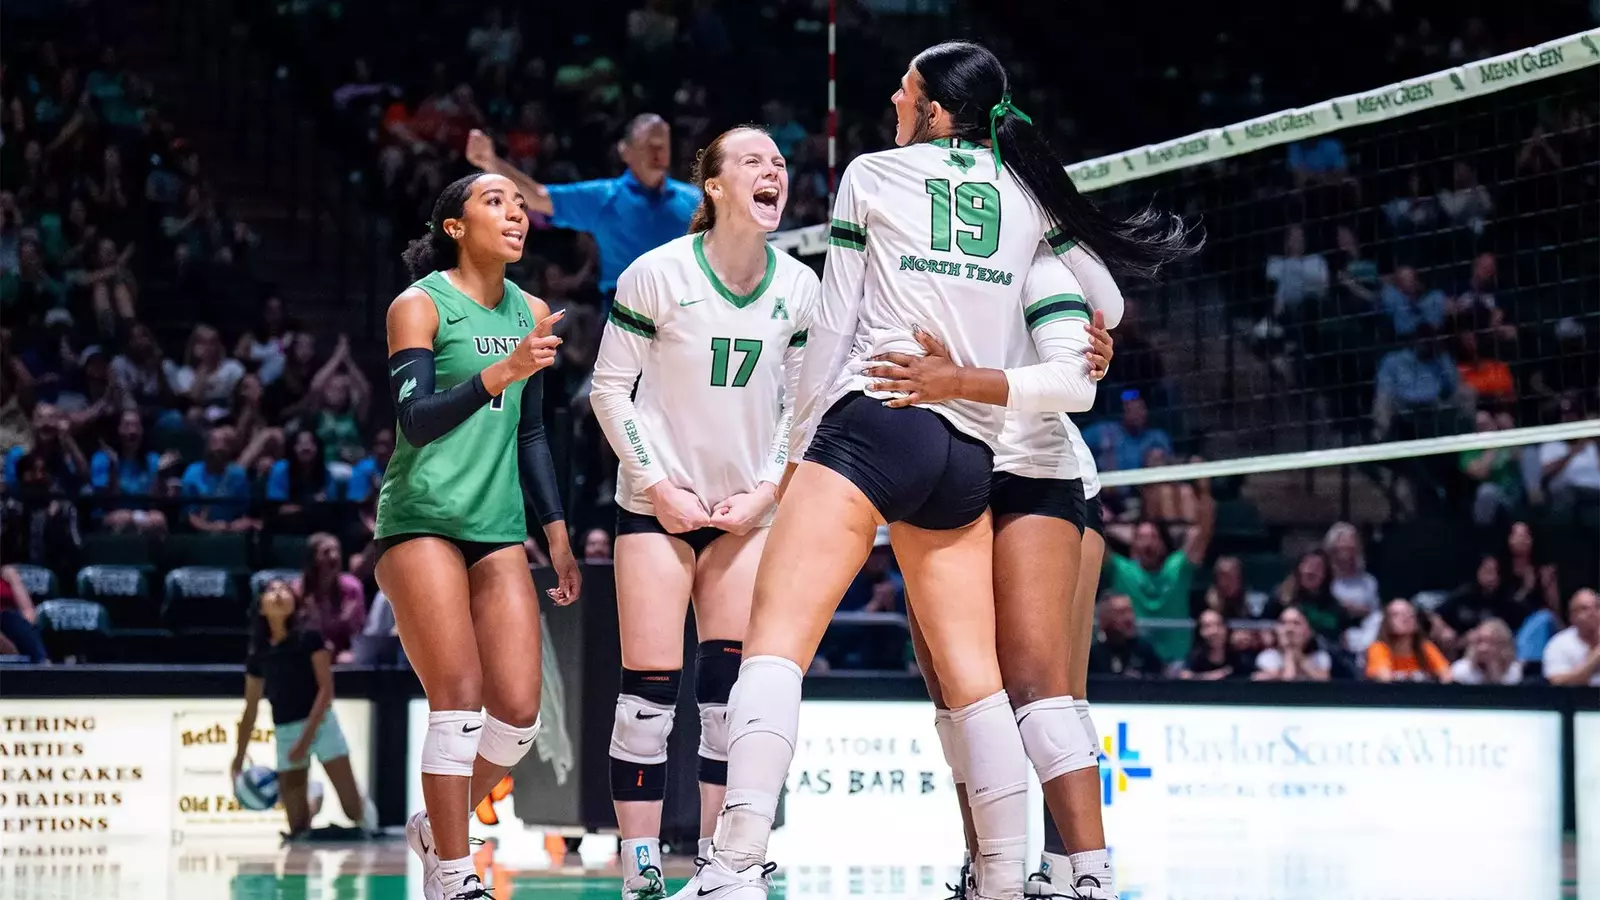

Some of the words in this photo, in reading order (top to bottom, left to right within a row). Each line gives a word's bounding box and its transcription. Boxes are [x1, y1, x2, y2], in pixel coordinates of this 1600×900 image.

[1479, 59, 1521, 84] MEAN
[1522, 46, 1564, 73] GREEN
[1356, 93, 1391, 115] MEAN
[1393, 82, 1435, 106] GREEN
[925, 178, 1001, 259] 19
[900, 255, 962, 277] NORTH
[965, 263, 1014, 286] TEXAS
[474, 336, 520, 356] UNT
[710, 337, 762, 388] 17
[623, 418, 641, 446] GREEN
[62, 766, 143, 782] CAKES
[847, 769, 905, 796] BAR
[179, 796, 209, 812] Old
